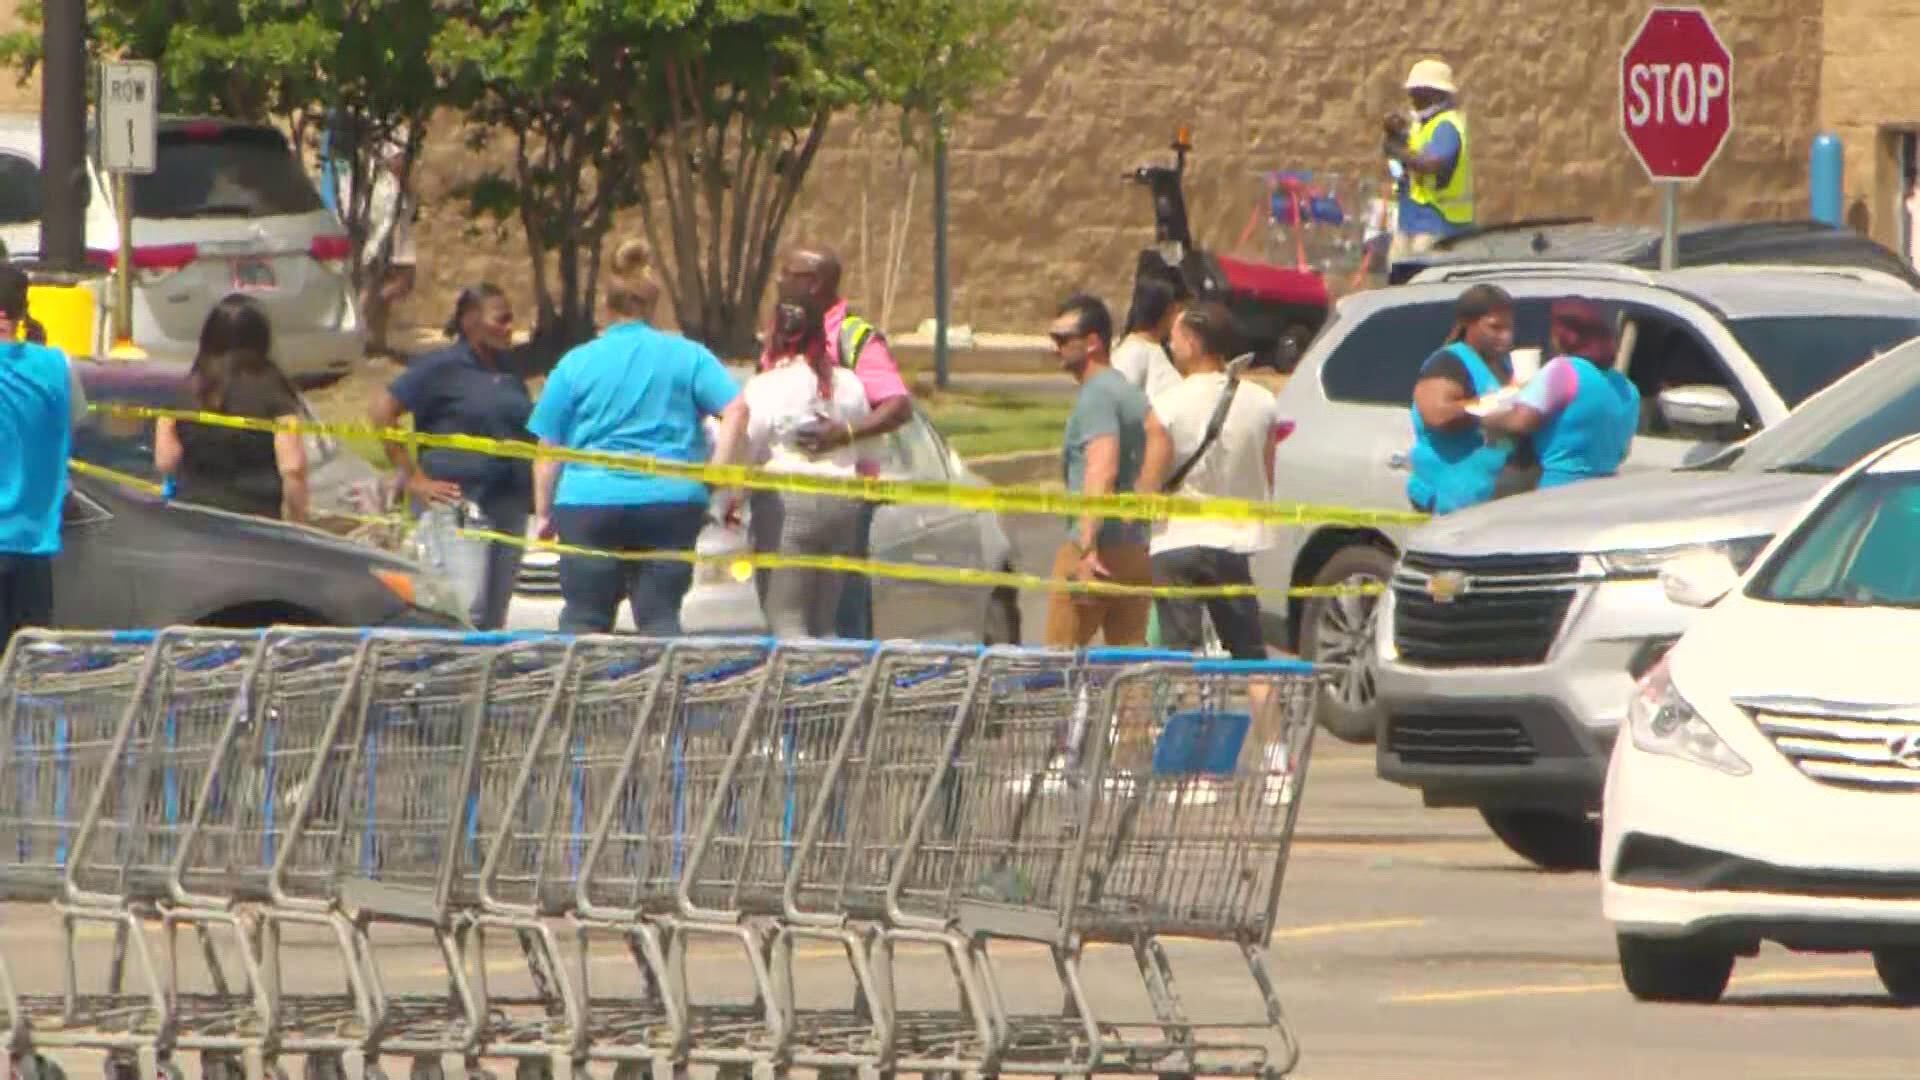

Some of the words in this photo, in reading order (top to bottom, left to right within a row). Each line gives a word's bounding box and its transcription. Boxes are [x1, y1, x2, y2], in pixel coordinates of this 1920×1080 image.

[111, 79, 146, 103] ROW
[1629, 62, 1725, 126] STOP
[127, 118, 135, 153] 1
